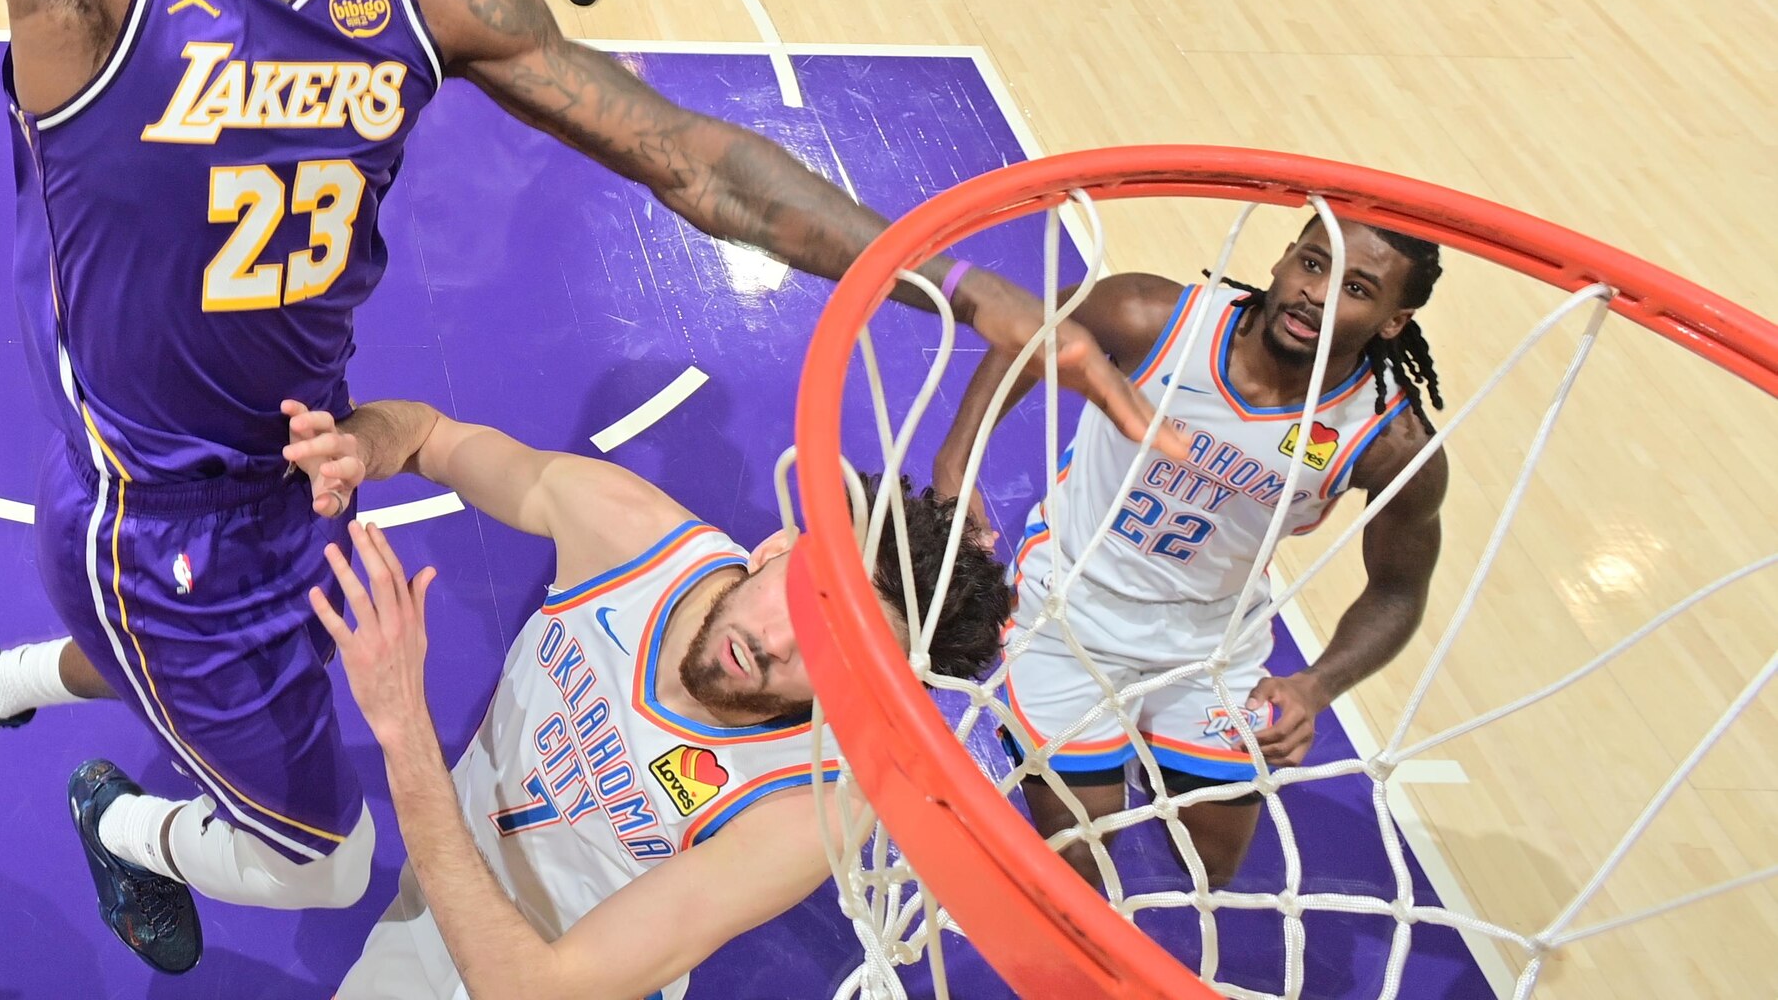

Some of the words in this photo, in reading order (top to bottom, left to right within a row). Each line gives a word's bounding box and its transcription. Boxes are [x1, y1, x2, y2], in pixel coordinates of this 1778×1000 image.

[140, 41, 408, 145] LAKERS
[201, 159, 367, 313] 23
[1106, 487, 1217, 565] 22
[1142, 458, 1239, 513] CITY
[534, 711, 600, 826] CITY
[537, 617, 676, 861] OKLAHOMA
[488, 767, 563, 838] 7
